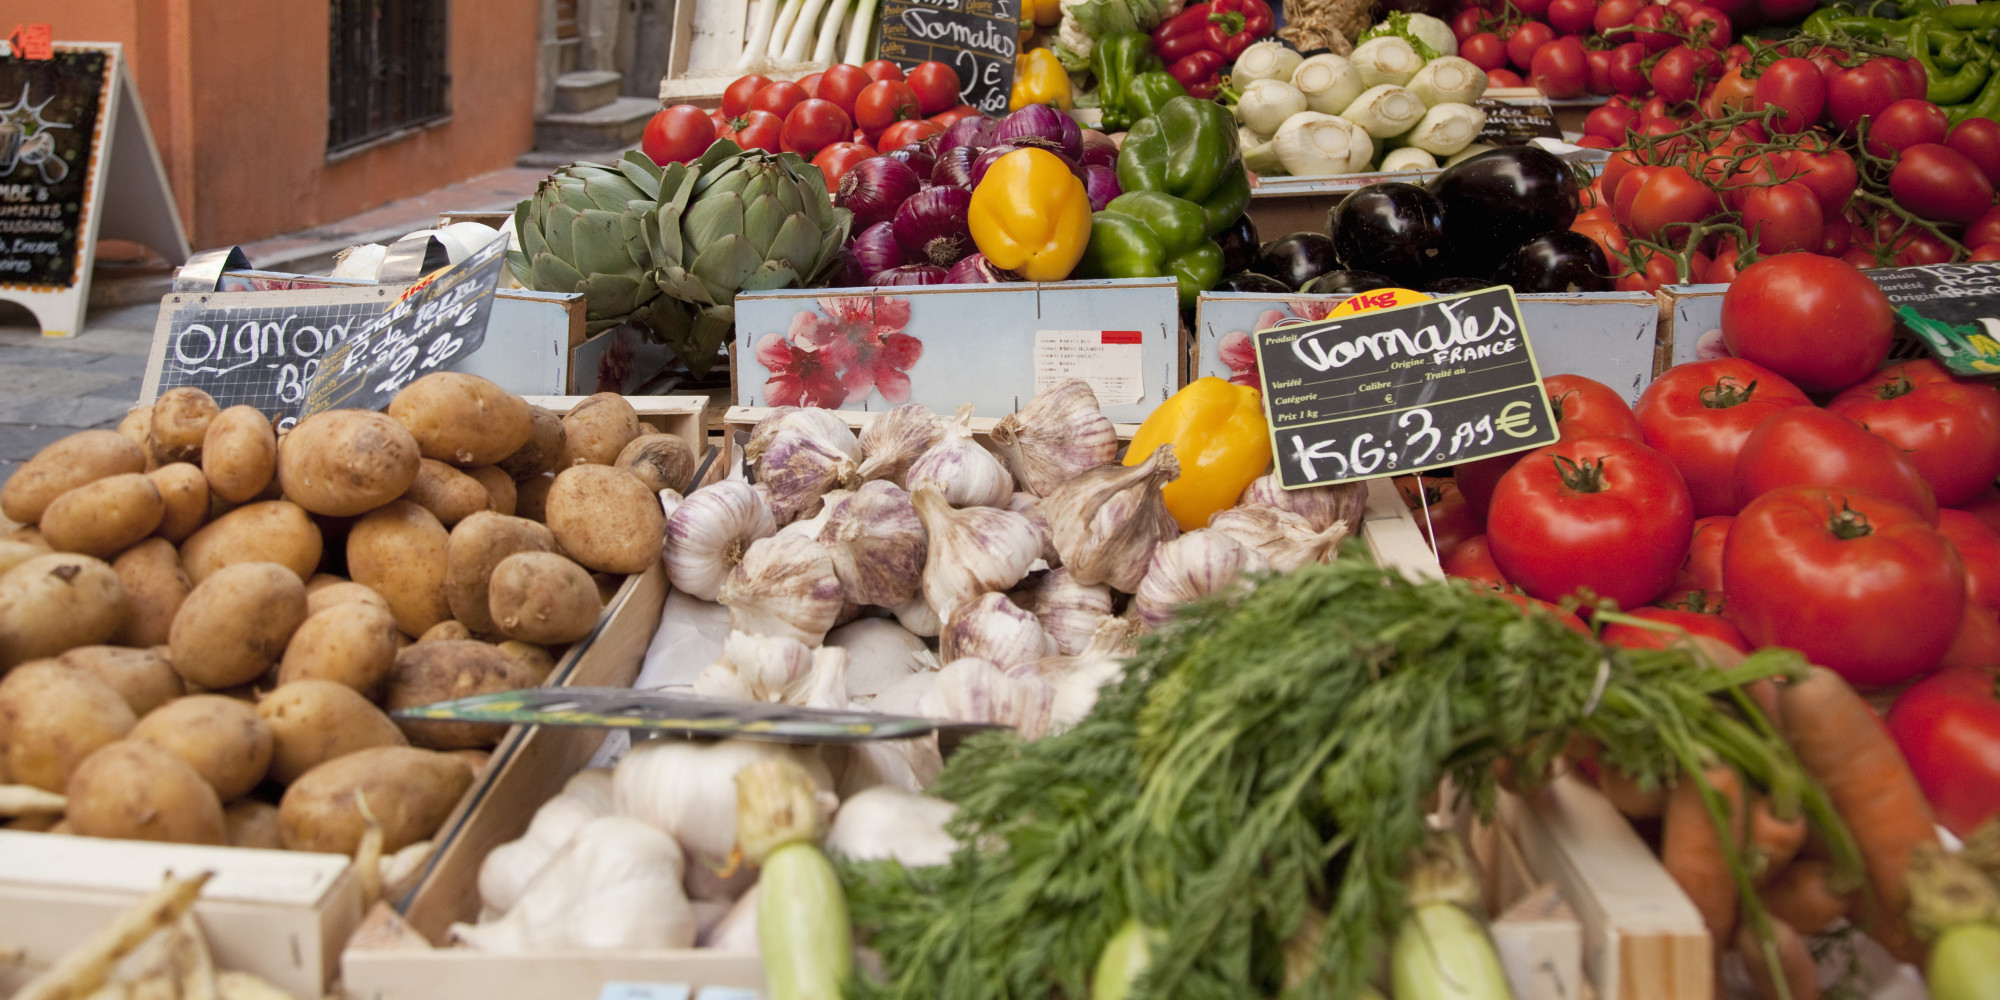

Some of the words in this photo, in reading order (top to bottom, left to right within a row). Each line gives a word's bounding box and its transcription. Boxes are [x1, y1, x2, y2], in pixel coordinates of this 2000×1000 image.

[902, 7, 1015, 57] Tomates
[1347, 291, 1398, 312] 1kg
[1265, 333, 1298, 346] Produit
[1291, 297, 1516, 372] Tomates
[1271, 377, 1303, 390] Variété
[1390, 358, 1425, 371] Origine
[1433, 338, 1517, 365] FRANCE
[1274, 392, 1318, 406] Catégorie
[1358, 381, 1392, 393] Calibre
[1425, 368, 1452, 382] Traité
[1277, 413, 1297, 422] Prix
[1307, 409, 1318, 420] kg
